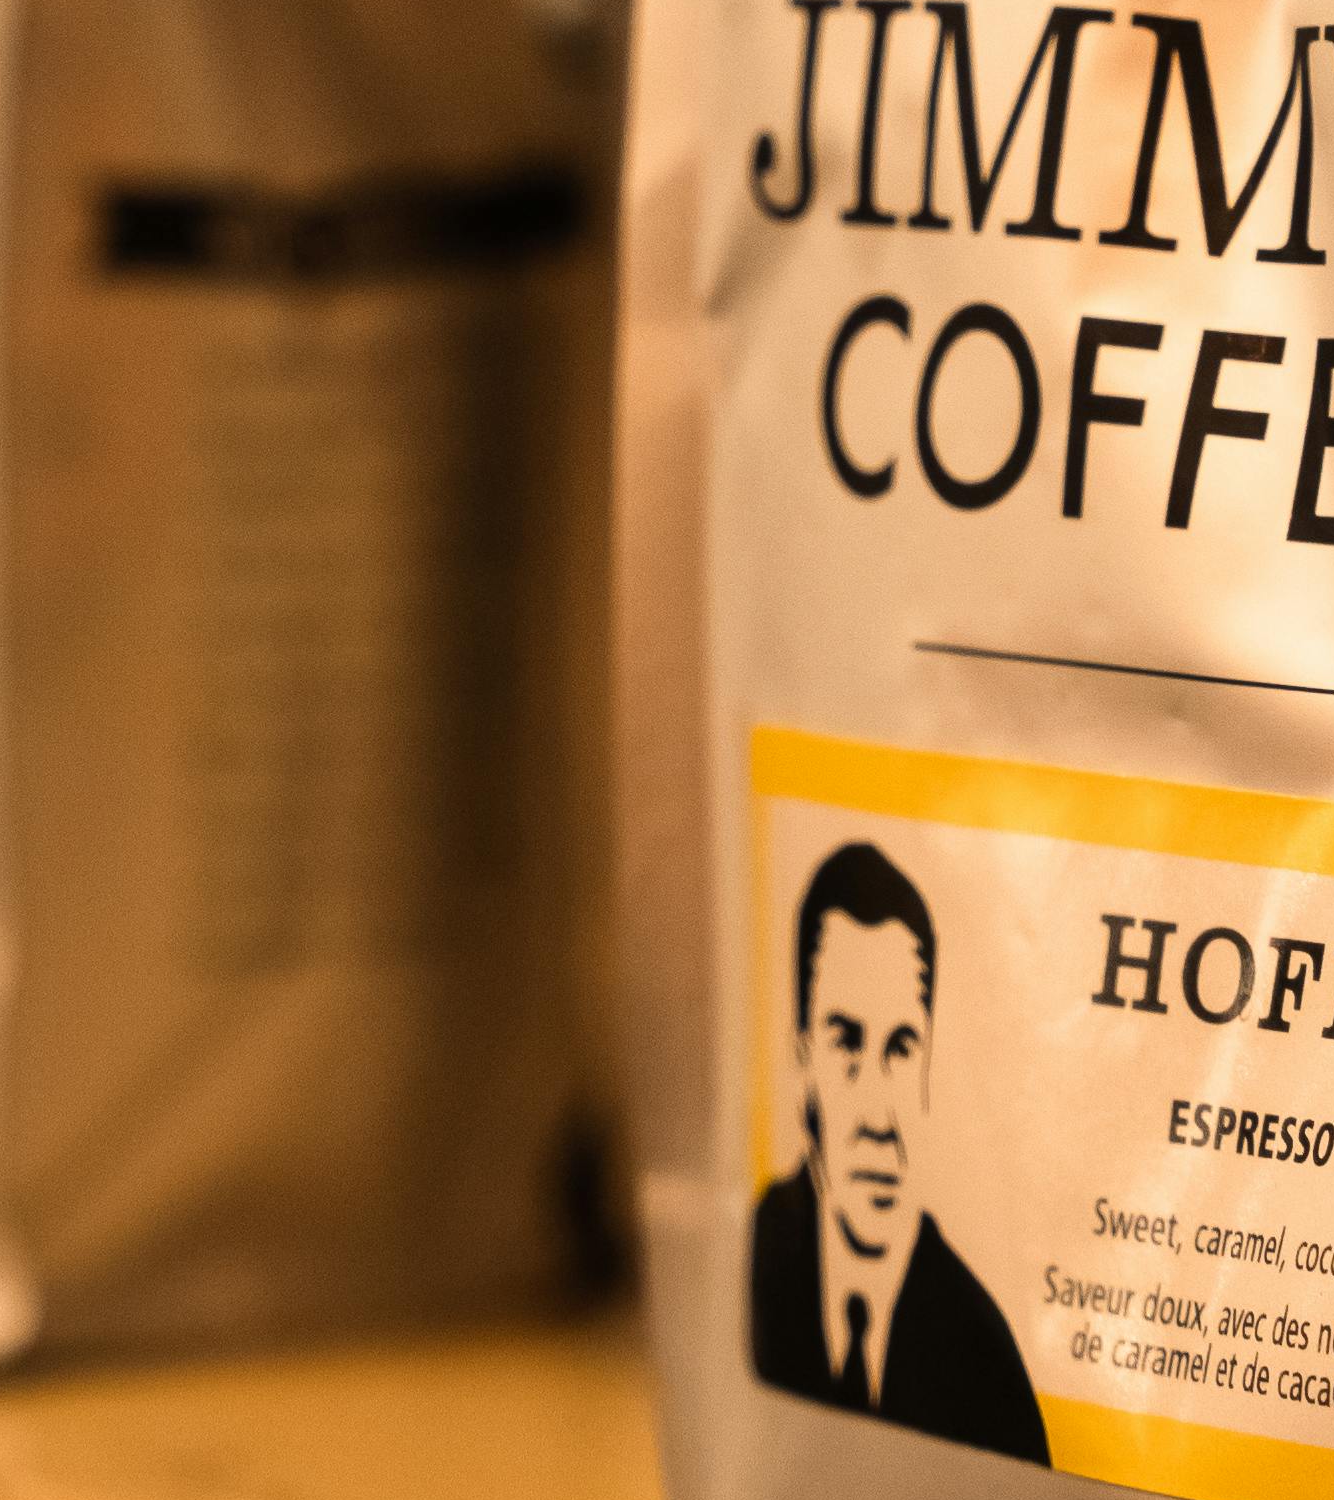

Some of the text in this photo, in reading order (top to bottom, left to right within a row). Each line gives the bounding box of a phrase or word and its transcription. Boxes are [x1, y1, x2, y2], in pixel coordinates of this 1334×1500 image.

[1093, 1196, 1183, 1256] Sweet,
[1194, 1225, 1287, 1274] caramel,
[1043, 1264, 1135, 1317] Saveur
[1142, 1282, 1208, 1338] doux,
[1217, 1305, 1267, 1343] avec
[1272, 1303, 1310, 1351] des
[1070, 1321, 1103, 1363] de
[1111, 1342, 1212, 1385] caramel
[1216, 1351, 1238, 1390] et
[1242, 1351, 1270, 1396] de
